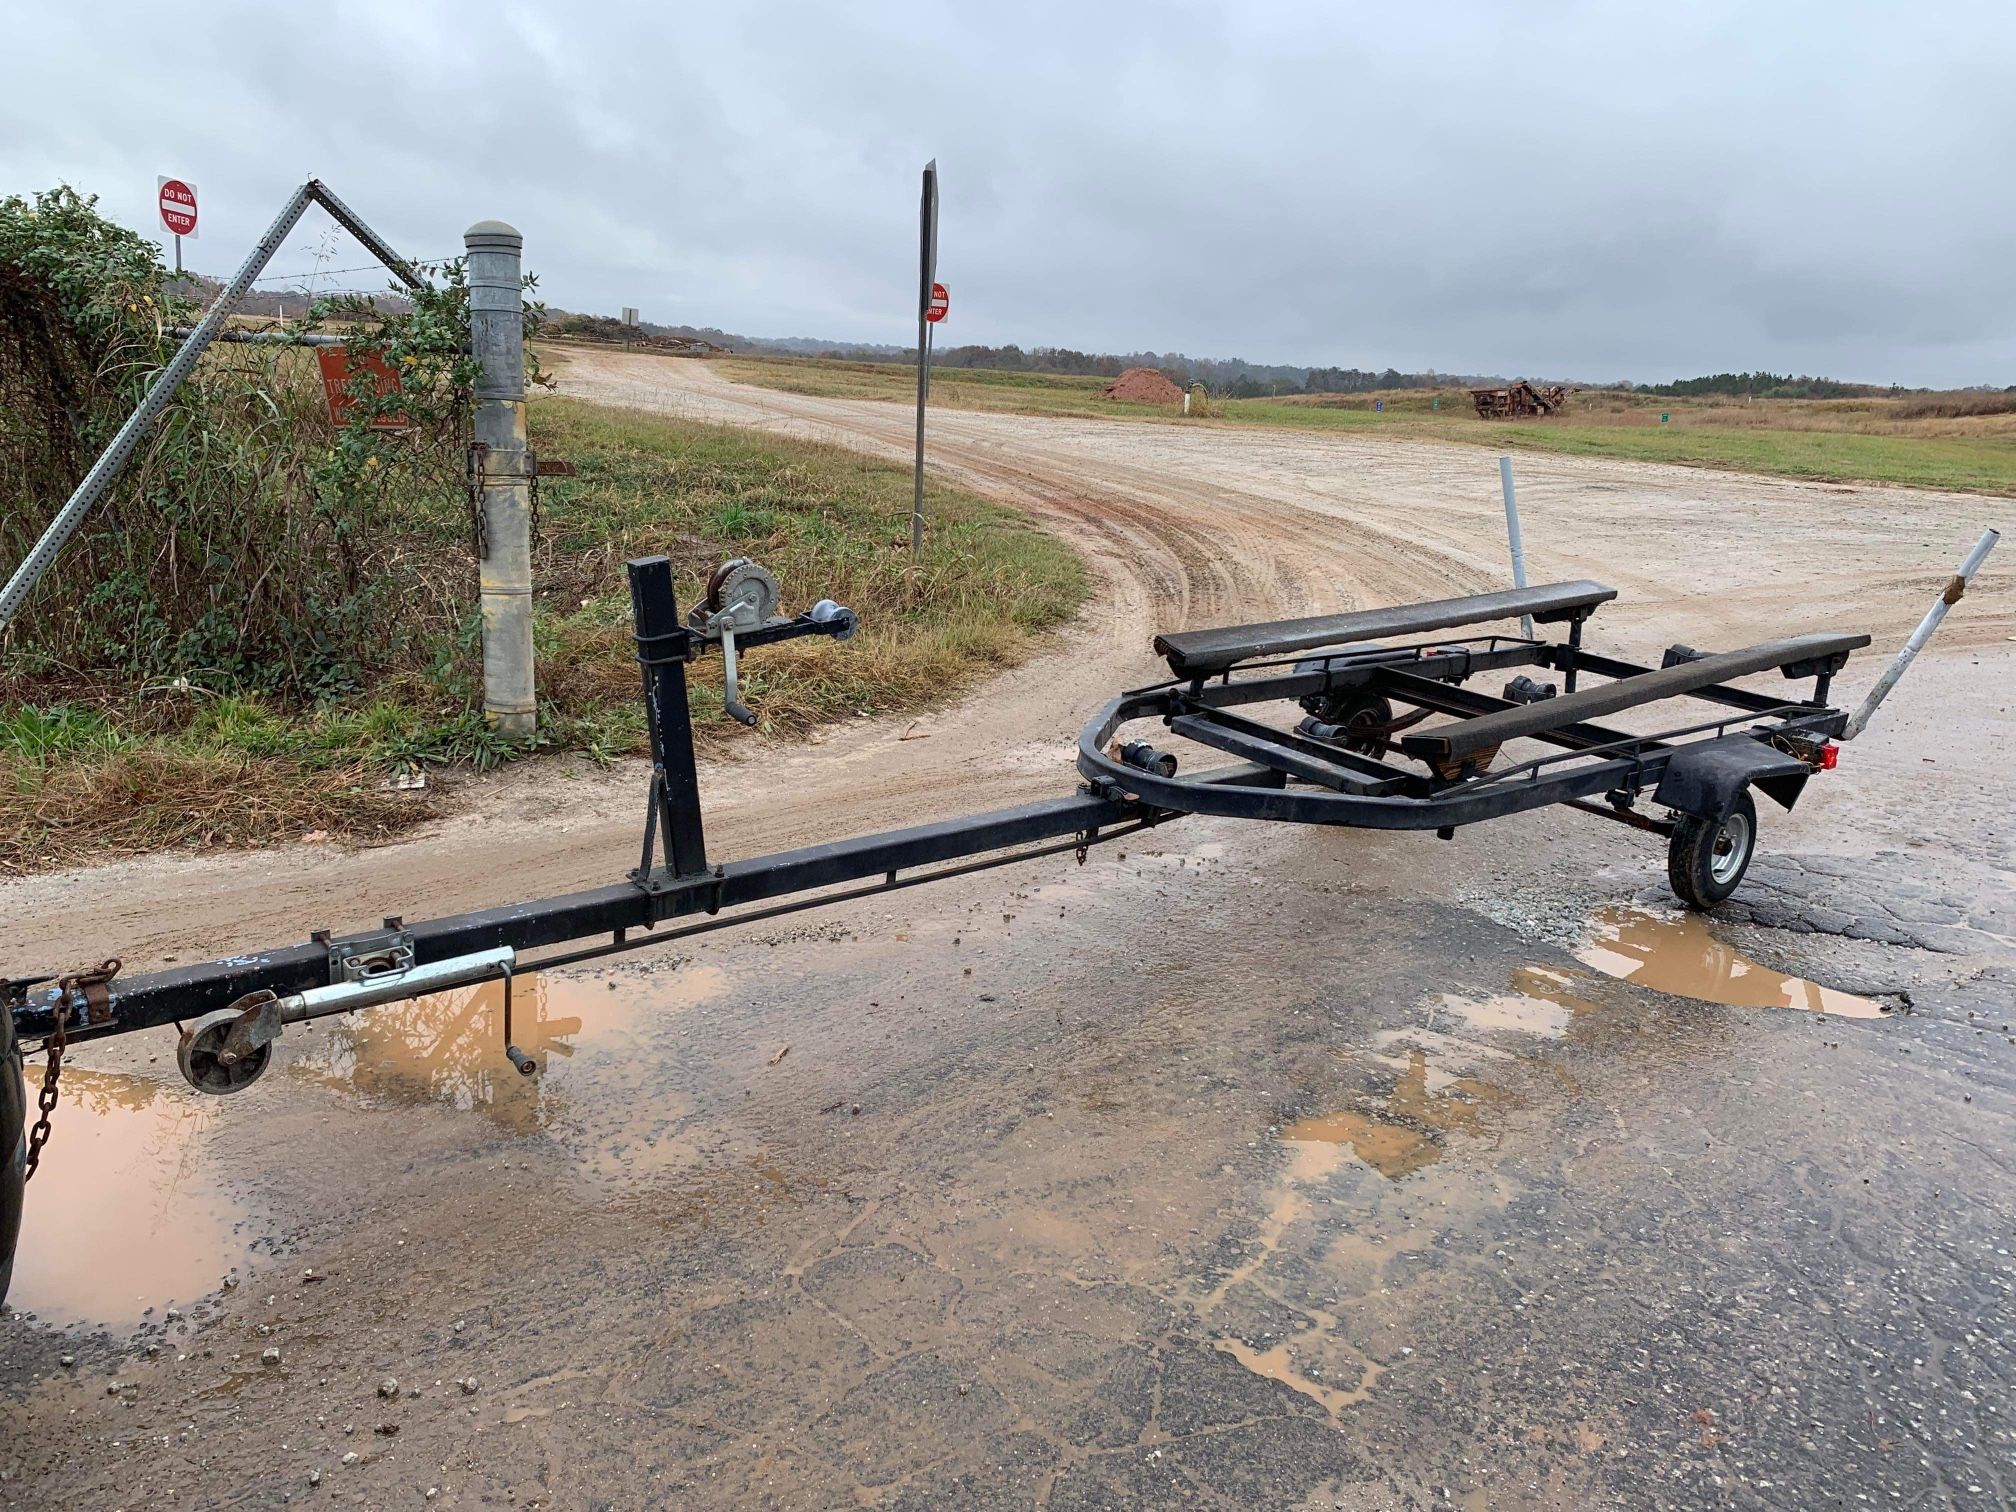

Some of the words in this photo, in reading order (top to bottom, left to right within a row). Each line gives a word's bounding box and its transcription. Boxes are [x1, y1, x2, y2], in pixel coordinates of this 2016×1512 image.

[164, 188, 175, 198] DO
[177, 191, 192, 203] NOT
[168, 213, 190, 226] ENTER
